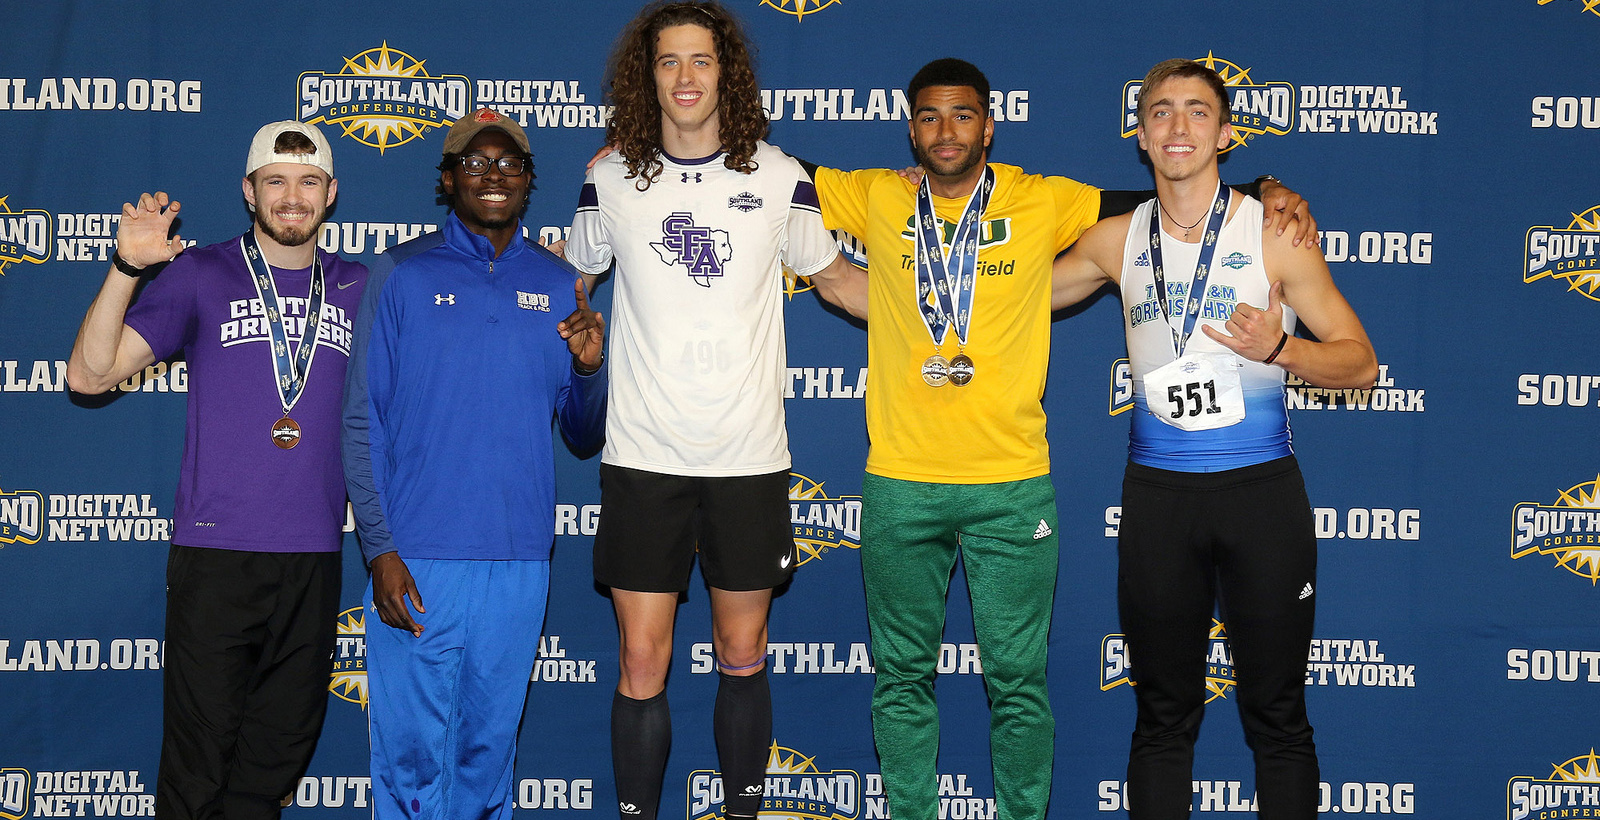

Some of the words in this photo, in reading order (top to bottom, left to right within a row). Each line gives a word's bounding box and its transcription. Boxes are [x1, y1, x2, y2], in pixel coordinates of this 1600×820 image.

[302, 76, 466, 119] SOUTHLAND
[476, 80, 585, 104] DIGITAL
[1300, 85, 1408, 110] DIGITAL
[330, 103, 438, 119] CONFERENCE
[476, 104, 616, 129] ETWORK
[1299, 110, 1439, 136] NETWORK
[661, 211, 724, 277] SFA
[516, 290, 550, 307] HBU
[1167, 379, 1222, 419] 551
[1286, 387, 1426, 412] NETWORK
[49, 494, 157, 518] DIGITAL
[48, 518, 174, 542] NETWOR
[1544, 534, 1600, 547] CONFE
[0, 639, 166, 671] LAND.OR
[1307, 639, 1385, 662] GITAL
[1304, 663, 1416, 687] ETWORK
[35, 771, 145, 794] DIGITAL
[33, 795, 156, 817] NETWOR
[692, 774, 856, 816] SOHLAND
